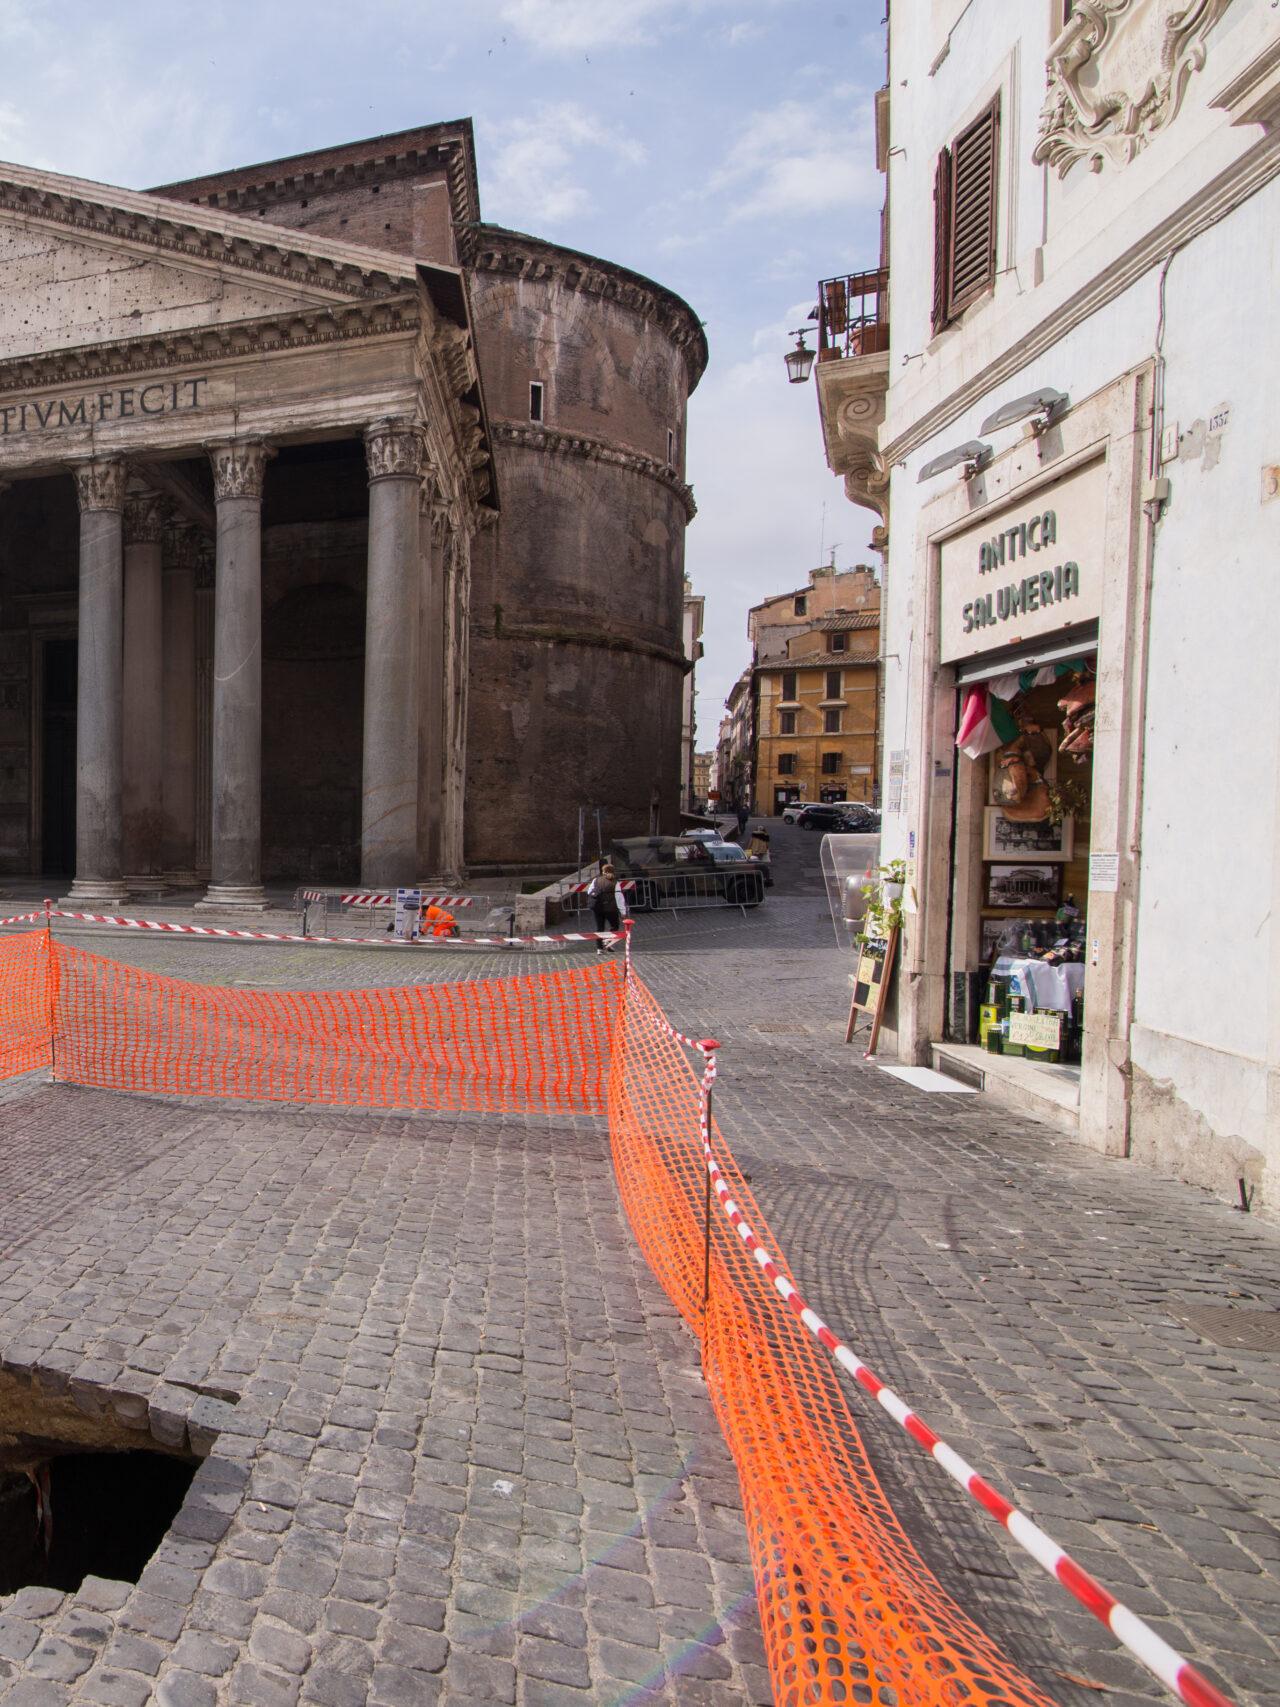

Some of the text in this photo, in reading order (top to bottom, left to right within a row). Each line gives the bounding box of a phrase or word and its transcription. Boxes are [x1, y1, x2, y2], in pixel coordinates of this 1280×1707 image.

[98, 378, 207, 419] FECIT
[979, 510, 1056, 576] ANTICA
[962, 561, 1079, 634] SALUMERIA
